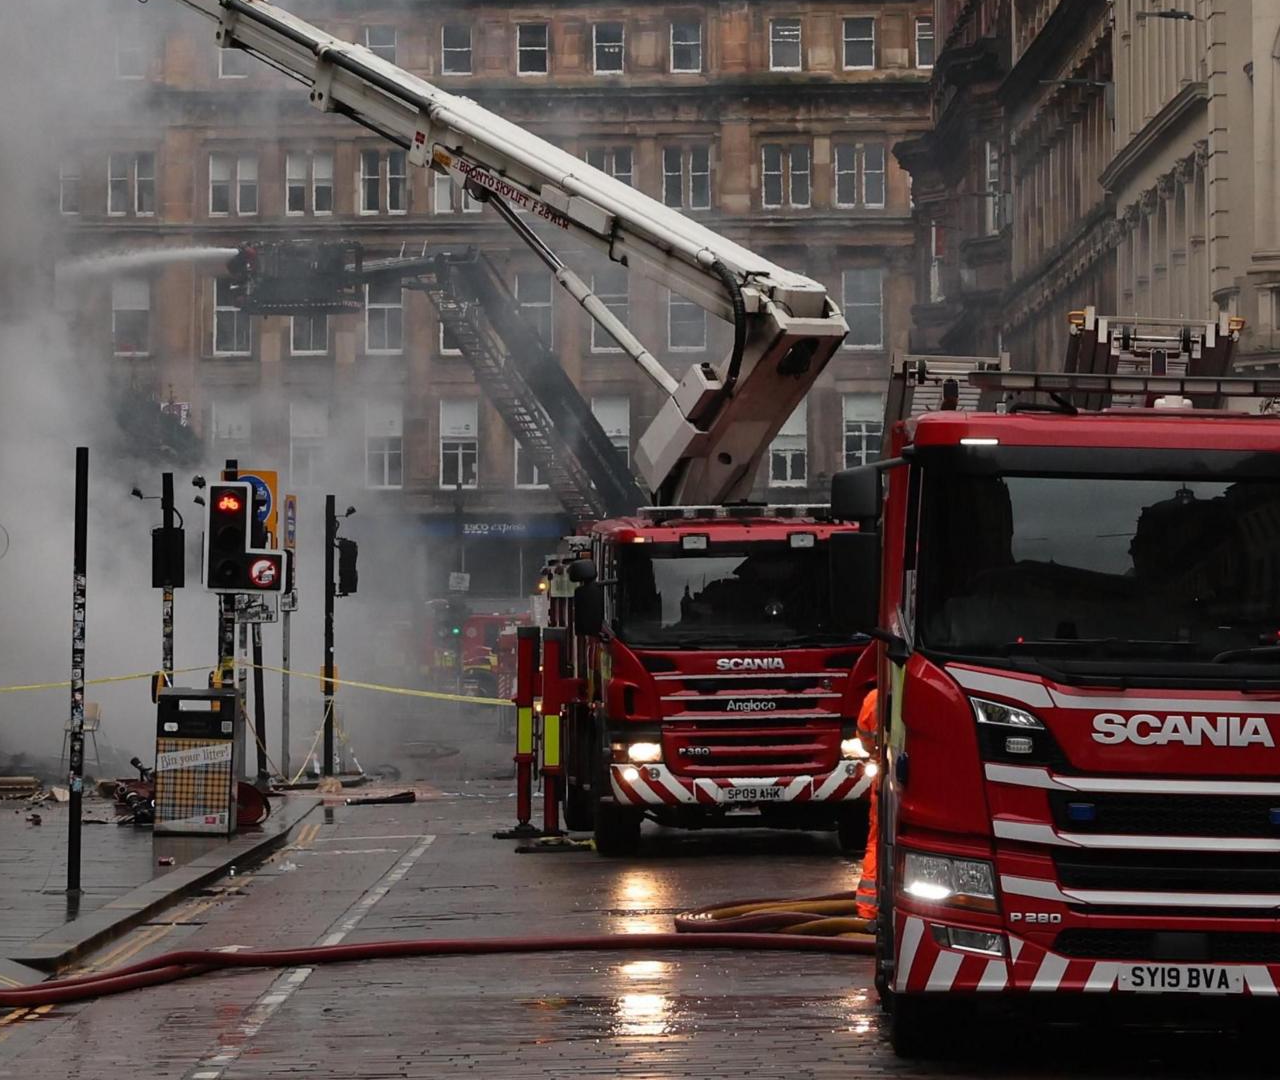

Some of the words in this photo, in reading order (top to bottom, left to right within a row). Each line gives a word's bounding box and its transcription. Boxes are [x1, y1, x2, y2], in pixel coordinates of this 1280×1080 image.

[459, 162, 495, 187] BRONTO
[495, 178, 529, 207] SKYLIFT
[716, 658, 784, 670] SCANIA
[726, 699, 776, 713] Angloco
[1091, 713, 1276, 748] SCANIA
[160, 754, 178, 770] Bin
[180, 751, 202, 766] your
[728, 788, 757, 800] SP09
[1009, 912, 1022, 923] P
[1024, 912, 1062, 924] 280
[1131, 966, 1181, 988] SY19
[1186, 967, 1231, 989] BVA
